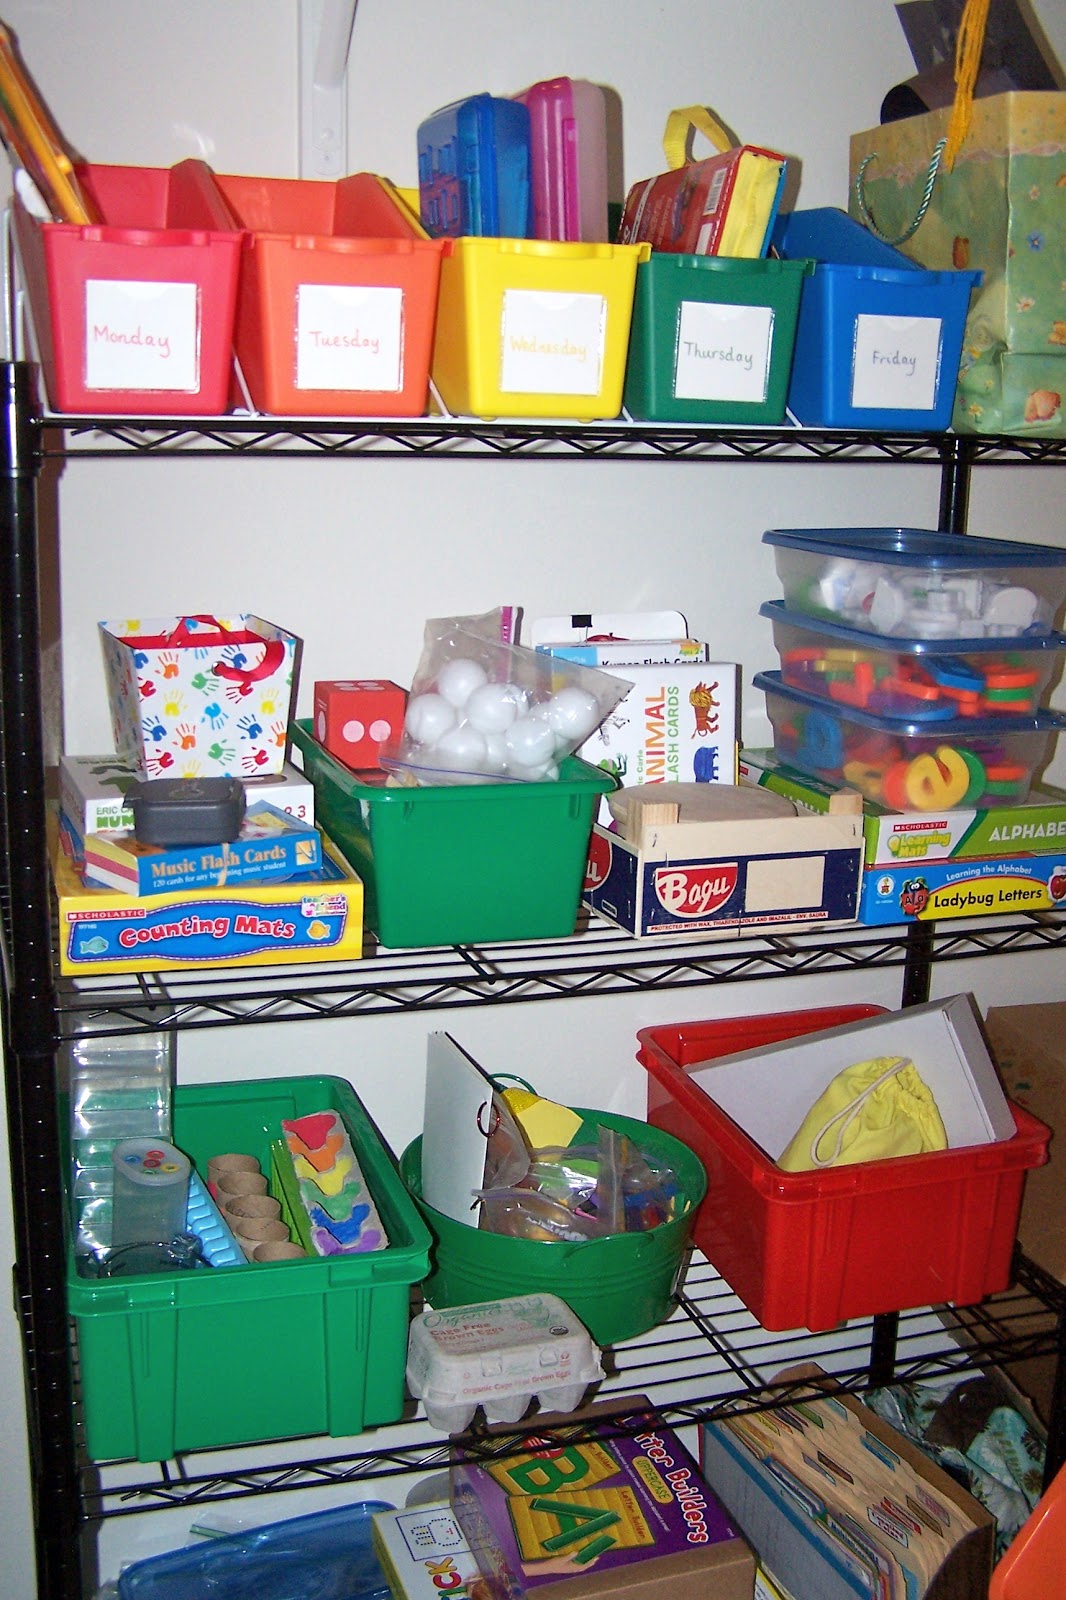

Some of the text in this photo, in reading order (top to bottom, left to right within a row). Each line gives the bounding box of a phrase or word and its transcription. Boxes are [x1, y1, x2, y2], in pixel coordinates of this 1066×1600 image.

[93, 325, 171, 358] Monday
[309, 330, 380, 354] Tuesday
[683, 341, 753, 371] Thursday
[872, 350, 916, 375] Friday
[668, 686, 679, 737] CARDS
[96, 806, 118, 815] ERIC
[901, 822, 947, 830] SCHOLASTIC
[900, 830, 951, 847] Learning
[151, 845, 287, 878] Music Flah Cards
[899, 845, 928, 858] Mats
[153, 861, 286, 888] 120 cards for any begning music student
[946, 864, 1032, 881] Learning the Alphabet
[656, 872, 731, 913] Bagu
[934, 889, 1042, 910] Ladybug Letters
[77, 910, 145, 919] SCHOLASTIC
[120, 915, 296, 947] Counting Mats
[430, 1322, 491, 1336] Cage Free
[432, 1327, 505, 1342] Brown Eggs
[462, 1385, 493, 1395] Organic
[494, 1382, 513, 1390] Cage
[531, 1373, 555, 1383] Brown
[637, 1459, 671, 1500] UPPERCASE
[621, 1489, 646, 1539] Letter Builder
[665, 1467, 709, 1543] Builders
